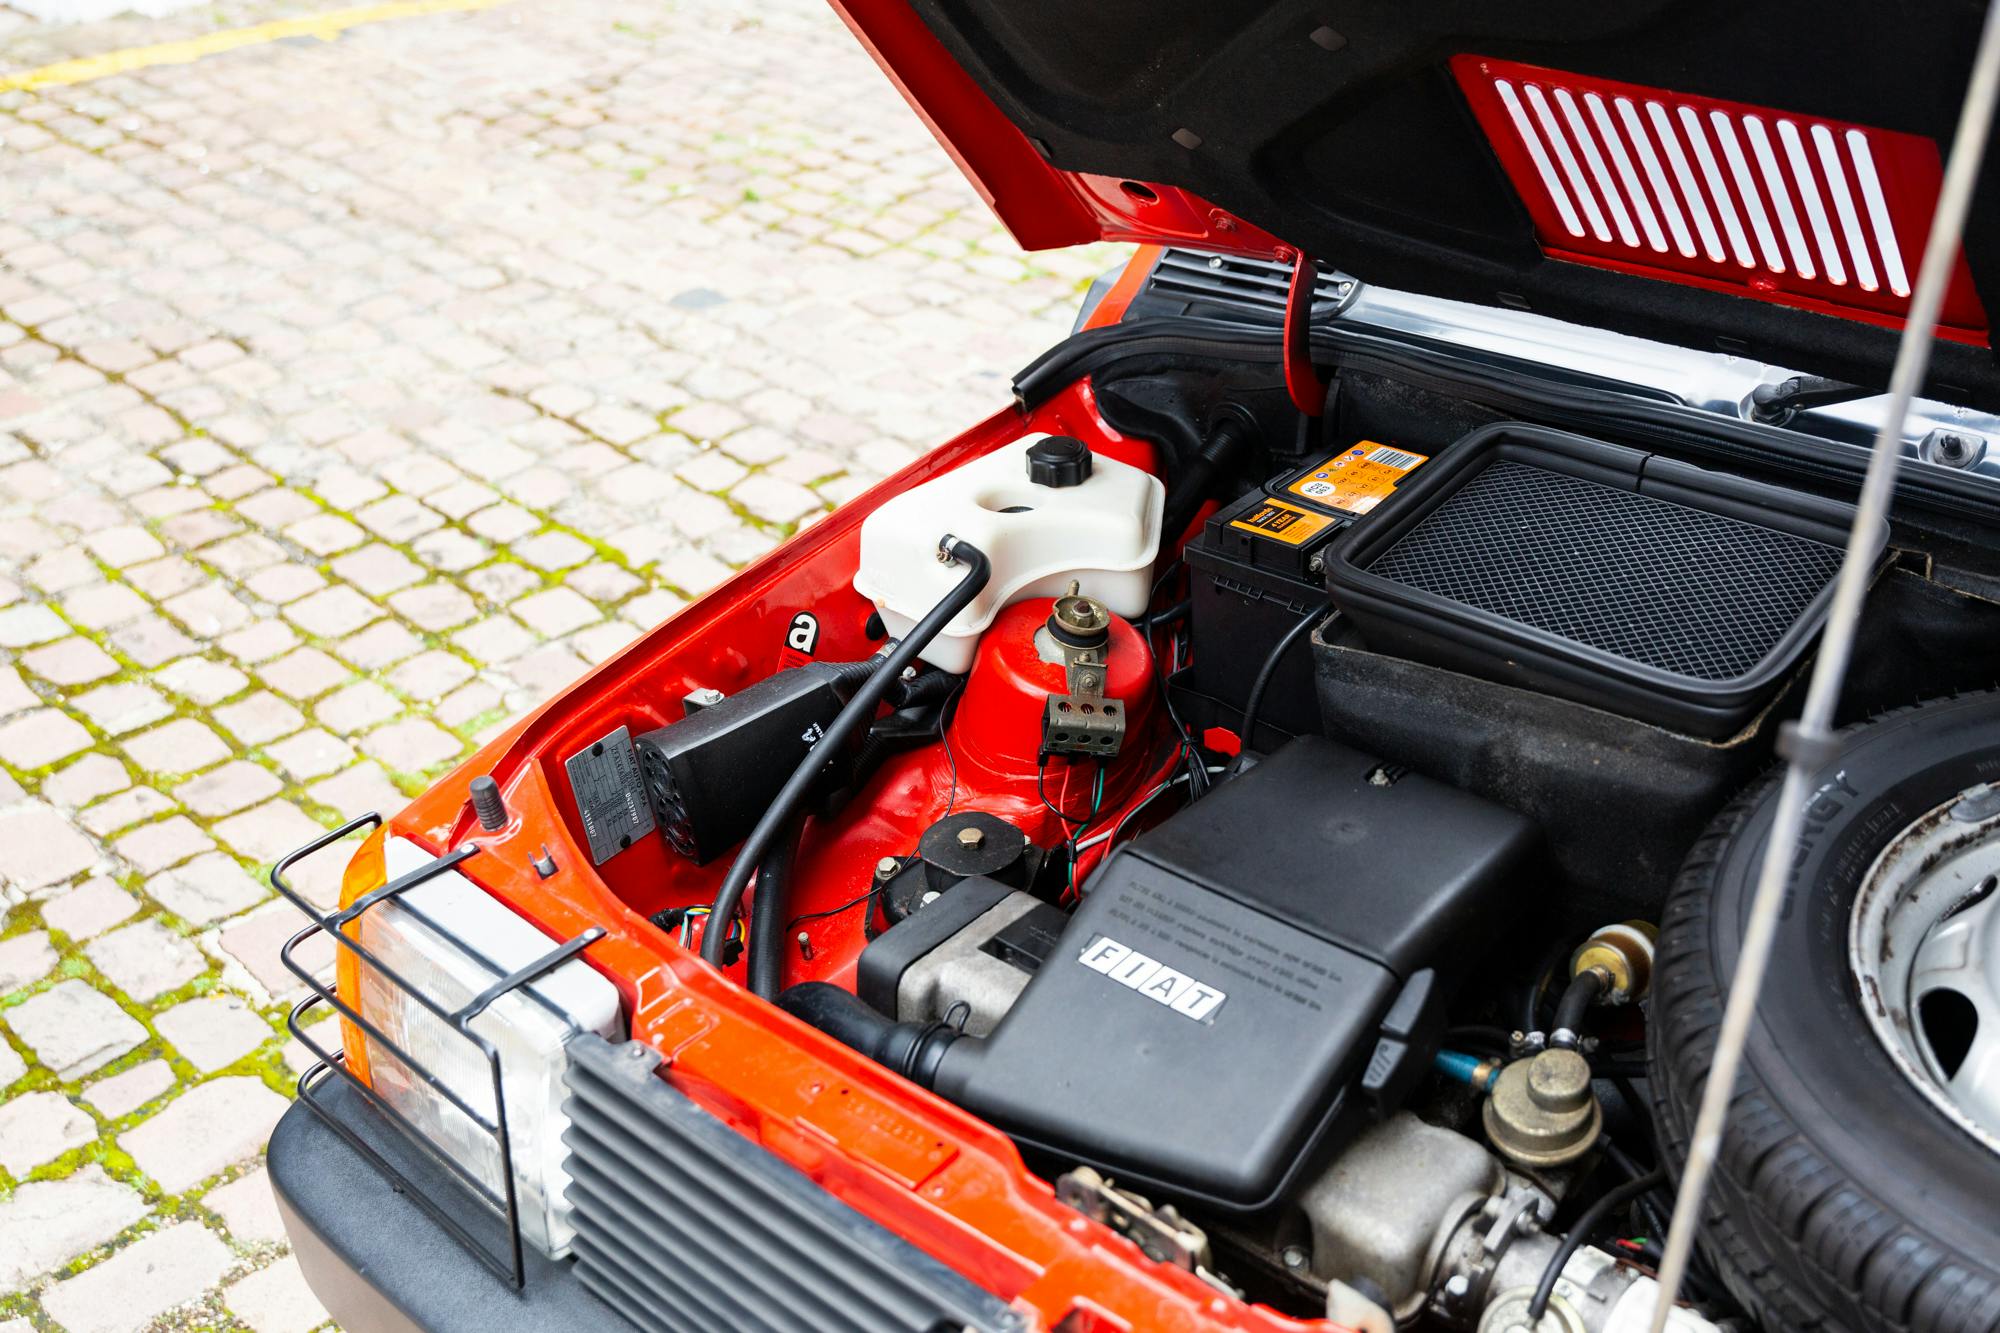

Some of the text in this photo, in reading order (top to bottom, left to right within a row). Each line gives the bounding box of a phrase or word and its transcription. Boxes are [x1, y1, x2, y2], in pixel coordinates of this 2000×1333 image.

[789, 614, 817, 653] a
[626, 747, 636, 764] FIAT
[631, 766, 642, 788] AUTO
[1085, 941, 1220, 1015] FIAT
